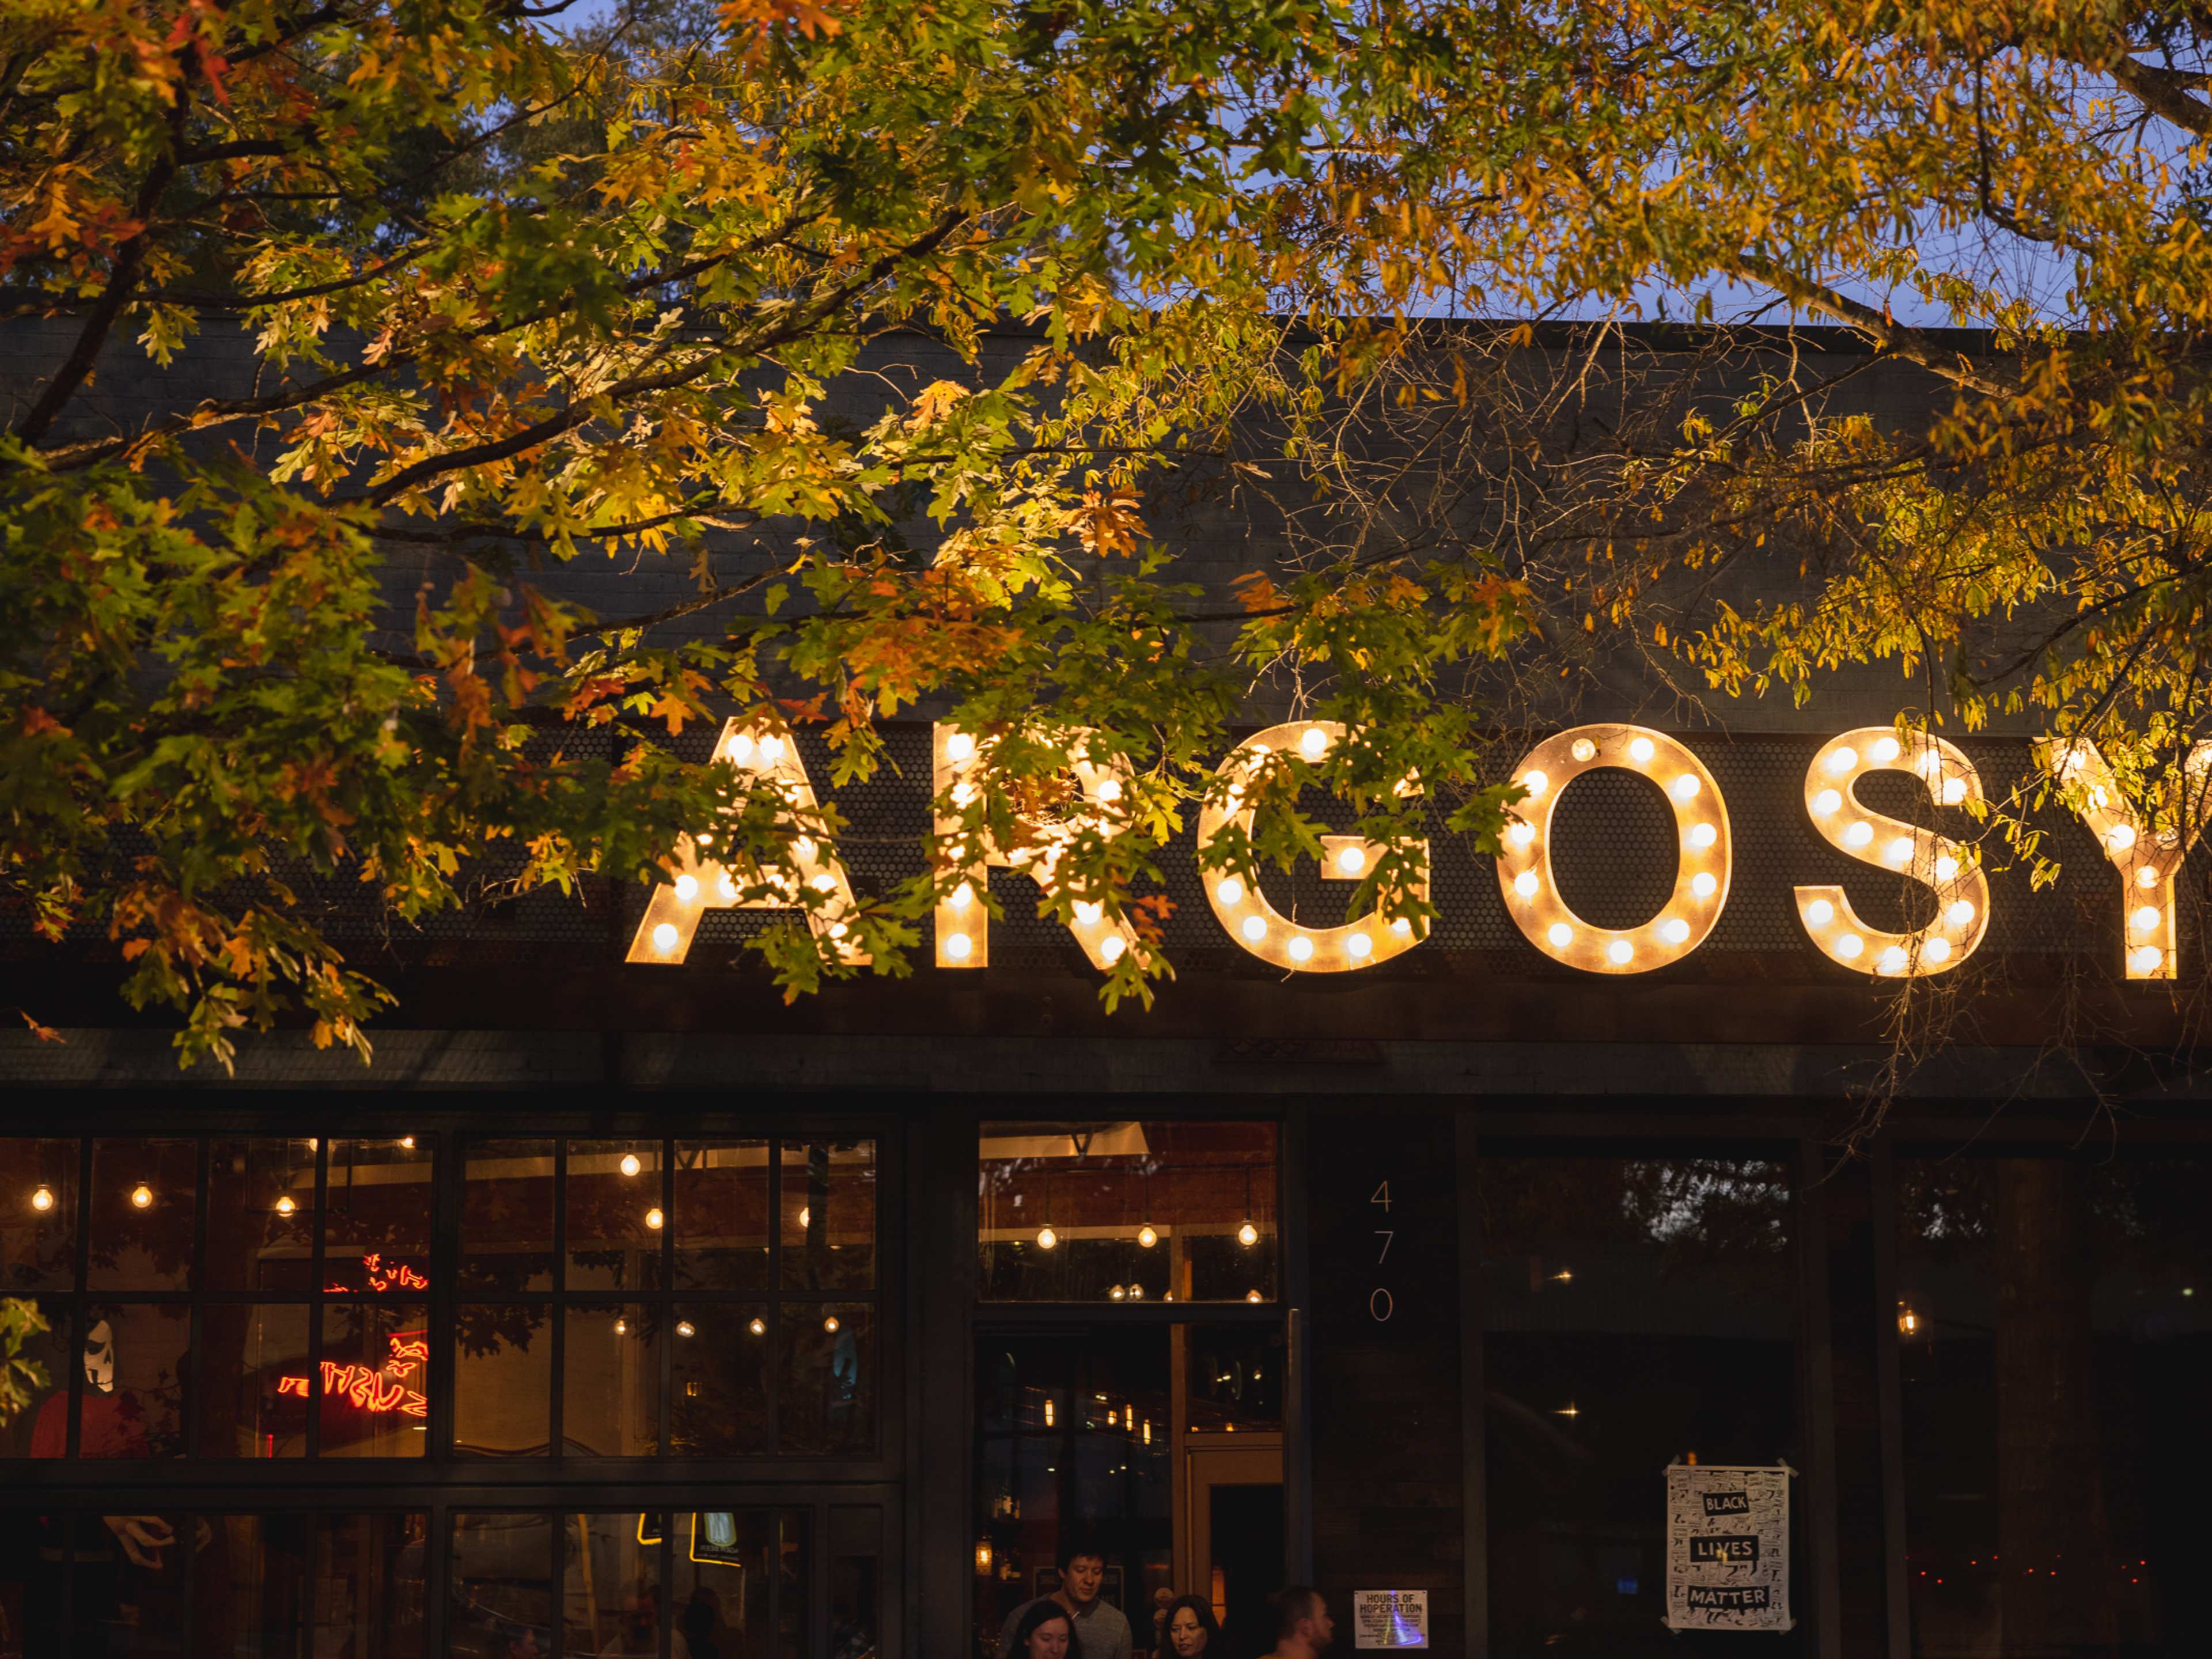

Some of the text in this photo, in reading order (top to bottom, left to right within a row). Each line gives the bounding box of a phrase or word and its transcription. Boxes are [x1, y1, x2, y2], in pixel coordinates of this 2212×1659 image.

[624, 715, 2212, 981] ARGOSY
[1369, 1179, 1394, 1323] 470
[1705, 1496, 1748, 1512] BLACK
[1697, 1540, 1753, 1556] LIVES
[1366, 1594, 1414, 1603] HOURS OF
[1690, 1589, 1766, 1605] MATTER
[1360, 1604, 1422, 1613] HOPERATION
